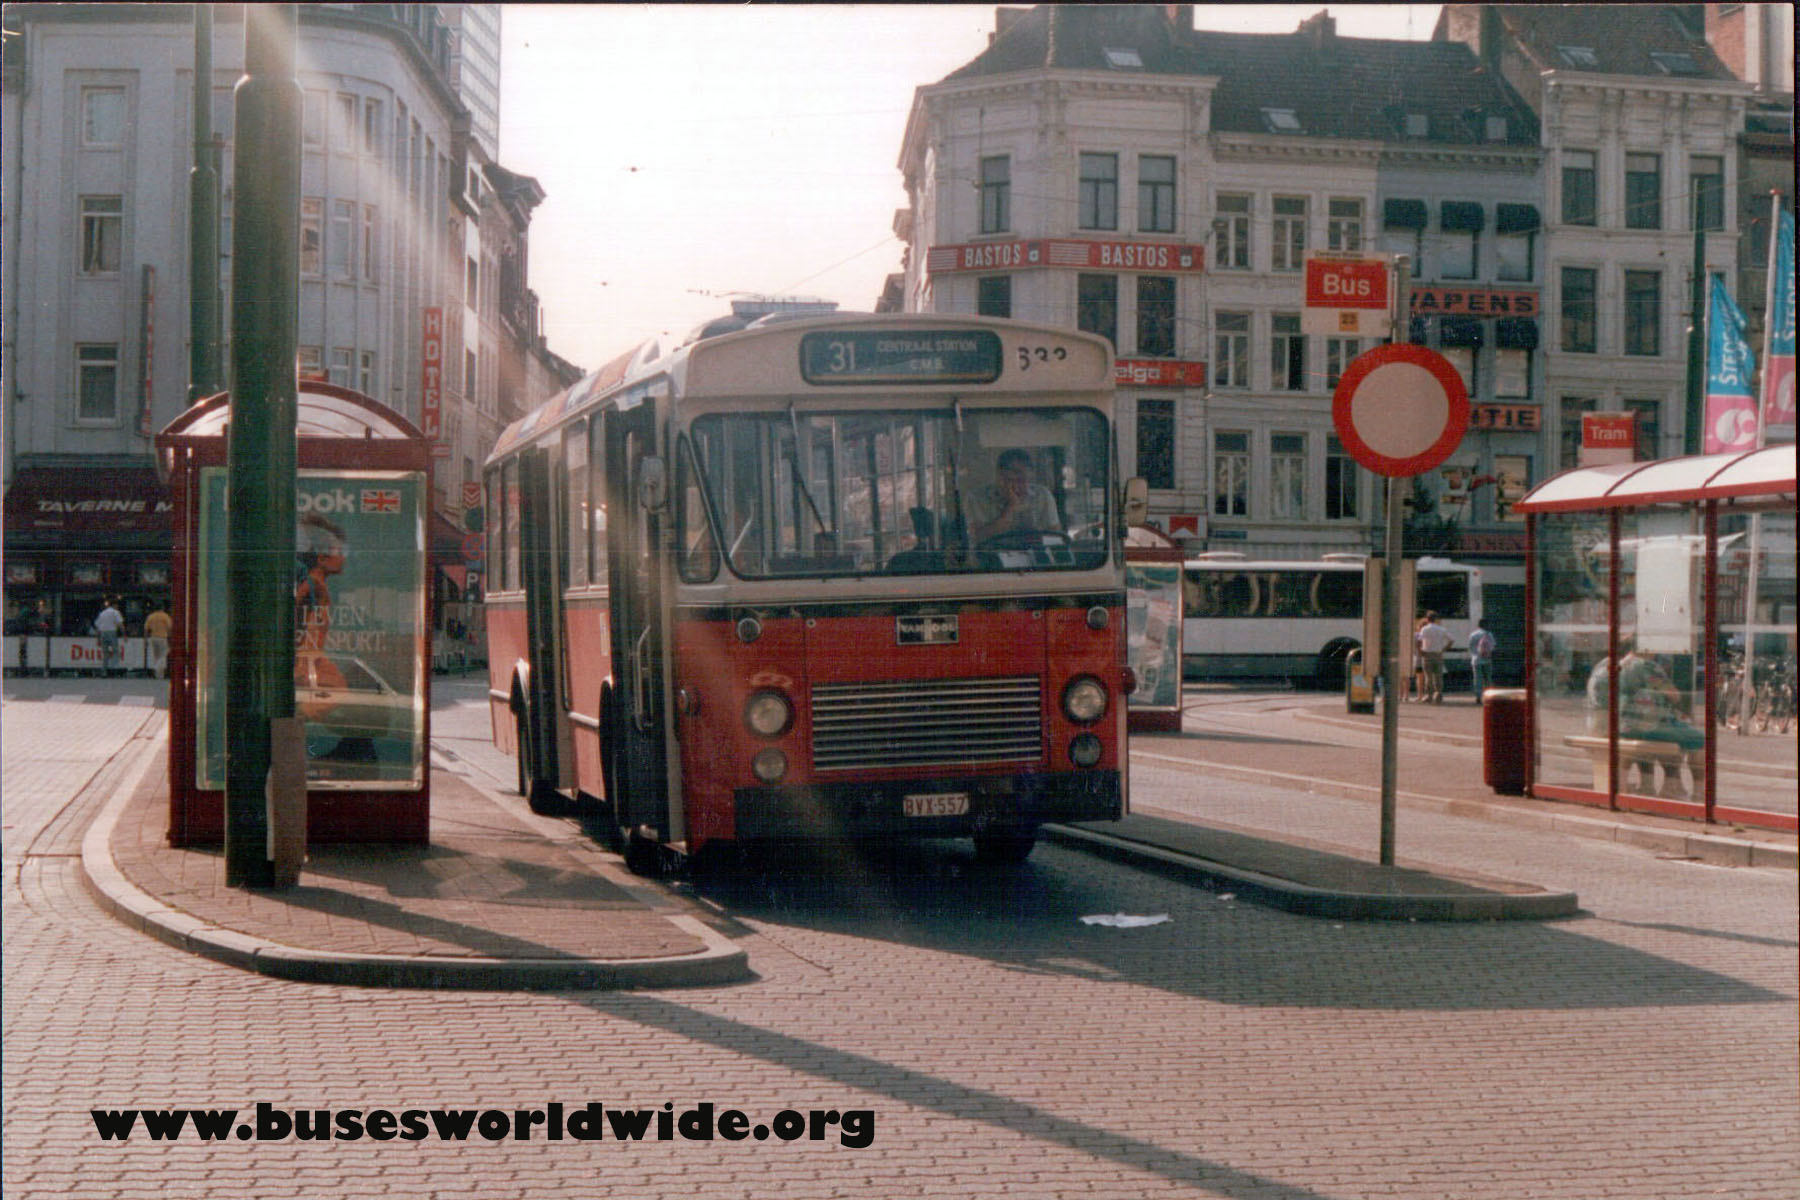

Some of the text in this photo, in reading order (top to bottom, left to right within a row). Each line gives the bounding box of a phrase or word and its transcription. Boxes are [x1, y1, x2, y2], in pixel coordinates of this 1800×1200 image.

[964, 244, 1021, 267] BASTOS
[1101, 244, 1168, 267] BASTOS
[1322, 273, 1371, 296] Bus
[829, 341, 857, 372] 31
[936, 339, 978, 352] STATION
[425, 312, 440, 438] HOTEL
[1114, 360, 1160, 383] elga
[1471, 408, 1535, 428] ITIE
[1590, 425, 1628, 441] Tram
[37, 501, 147, 512] TAVERNE
